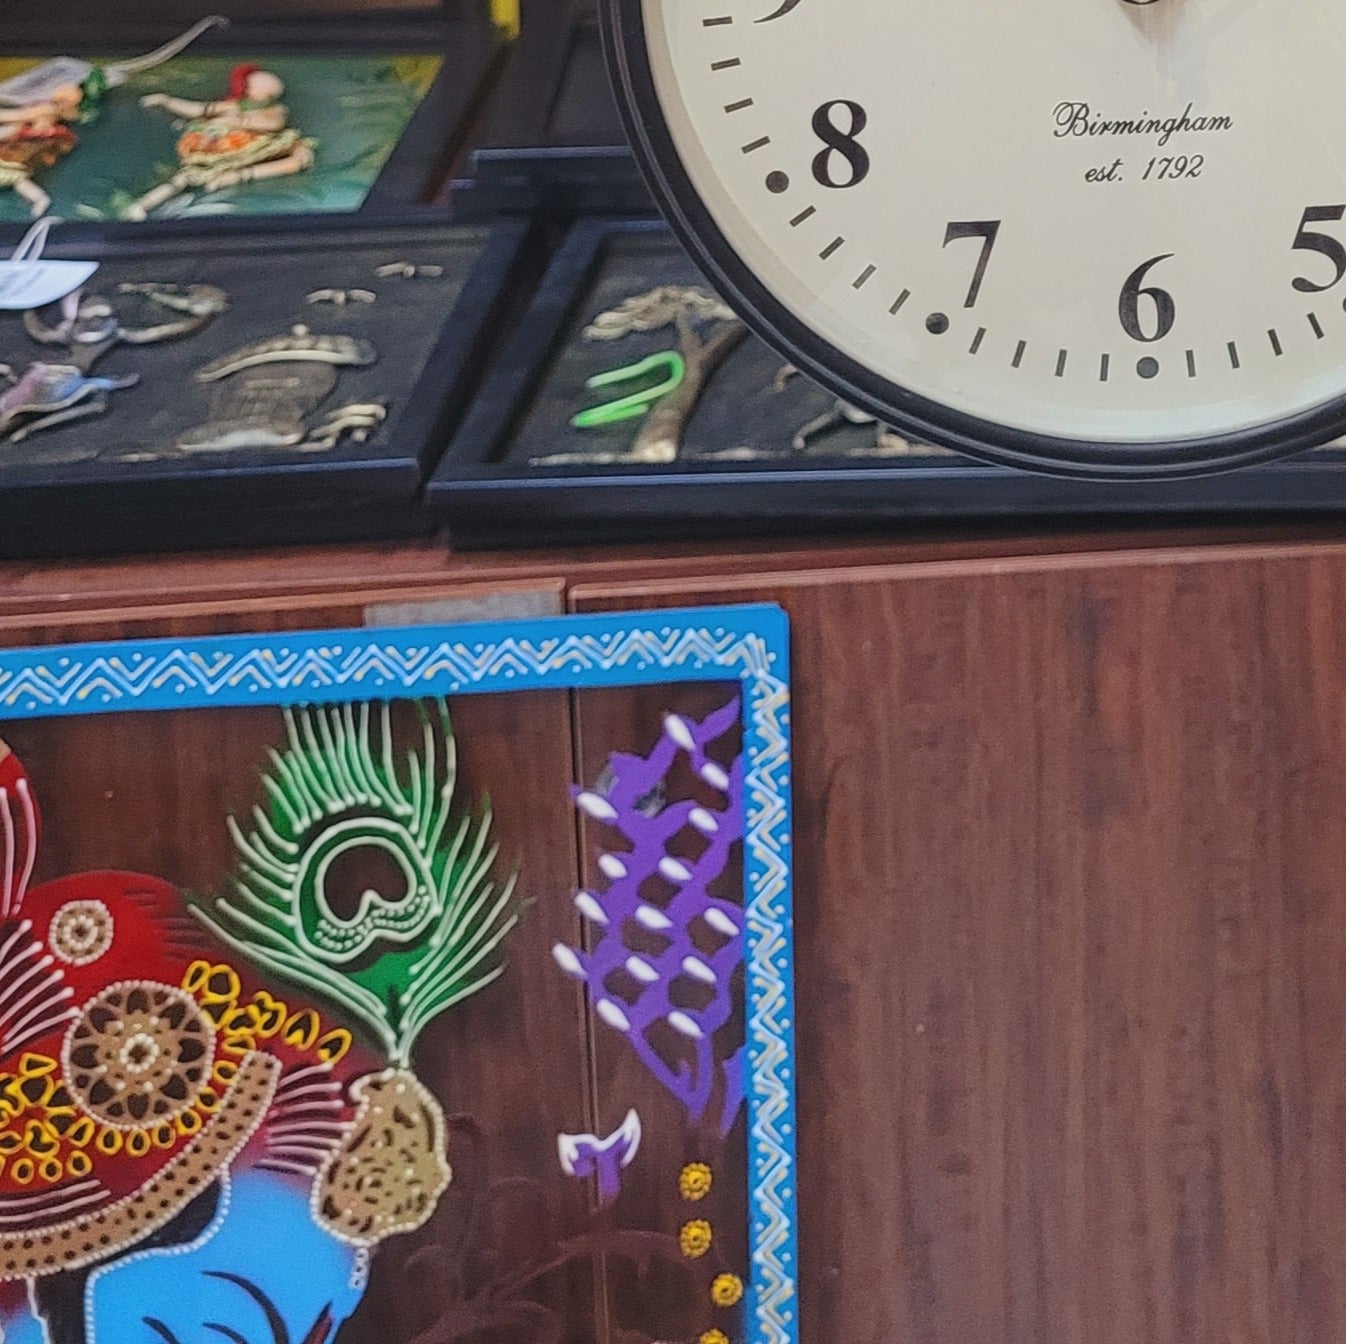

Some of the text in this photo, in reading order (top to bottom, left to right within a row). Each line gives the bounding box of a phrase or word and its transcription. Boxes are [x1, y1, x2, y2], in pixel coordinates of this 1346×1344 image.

[812, 100, 869, 188] 8
[1053, 102, 1232, 146] Birmingham
[1085, 155, 1203, 182] est. 1792
[943, 220, 1001, 308] 7
[1292, 205, 1346, 292] 5
[1119, 254, 1175, 342] 6
